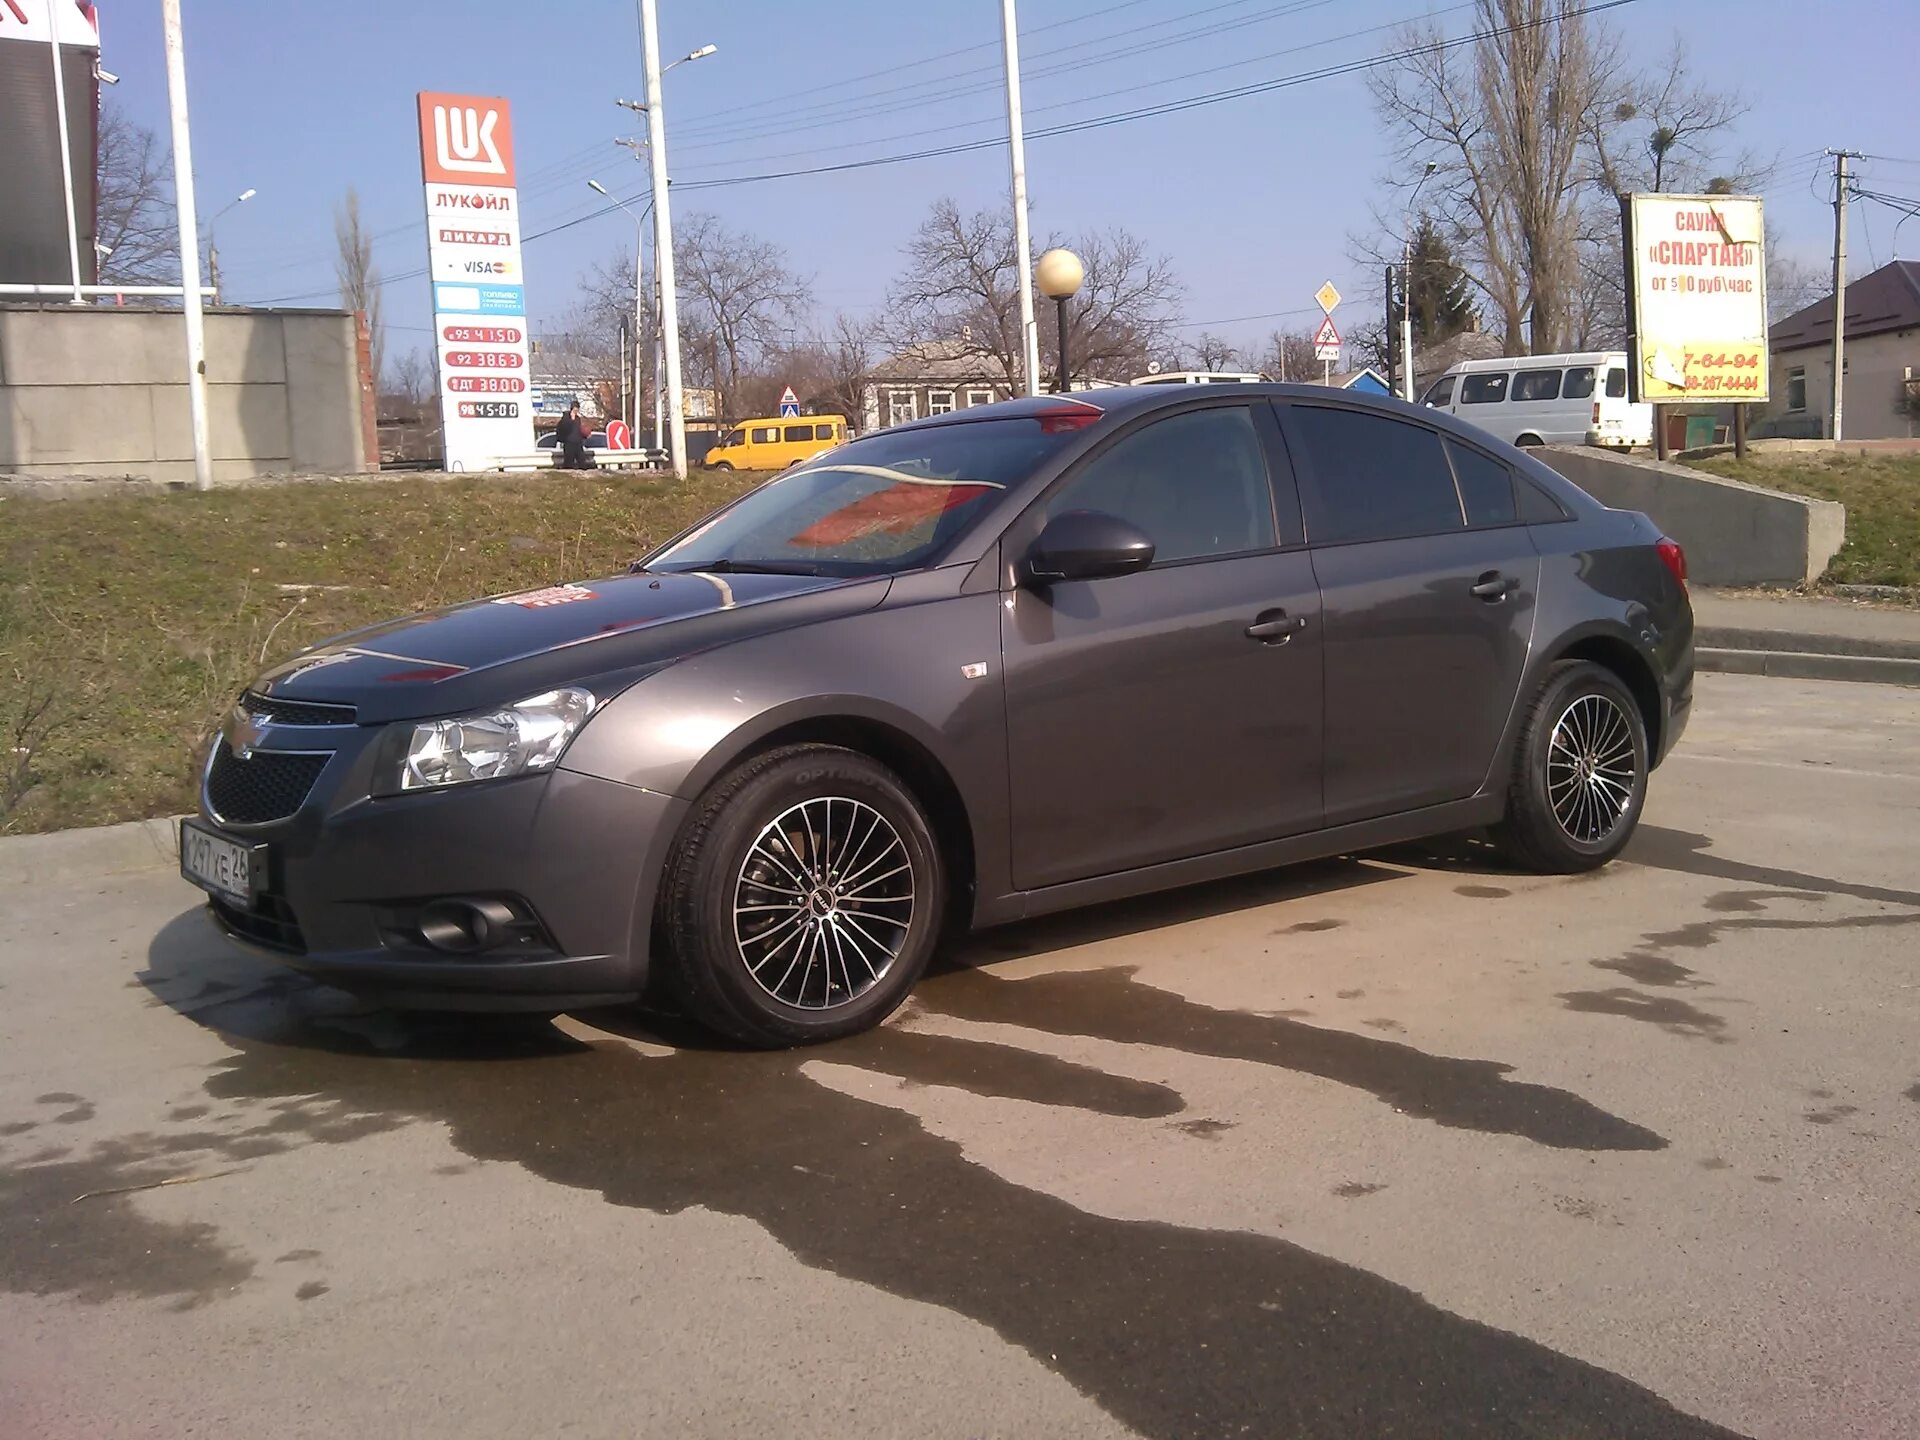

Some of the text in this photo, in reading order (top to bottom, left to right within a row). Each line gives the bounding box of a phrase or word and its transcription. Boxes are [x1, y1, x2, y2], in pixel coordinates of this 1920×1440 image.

[436, 193, 510, 211] ЛУКОЙЛ
[442, 231, 509, 246] ЛИКАРД
[464, 261, 493, 274] VISA
[1671, 275, 1695, 292] 50
[455, 329, 470, 340] 95
[456, 354, 472, 365] 92
[459, 379, 474, 391] ДТ
[795, 767, 875, 786] OPTIO
